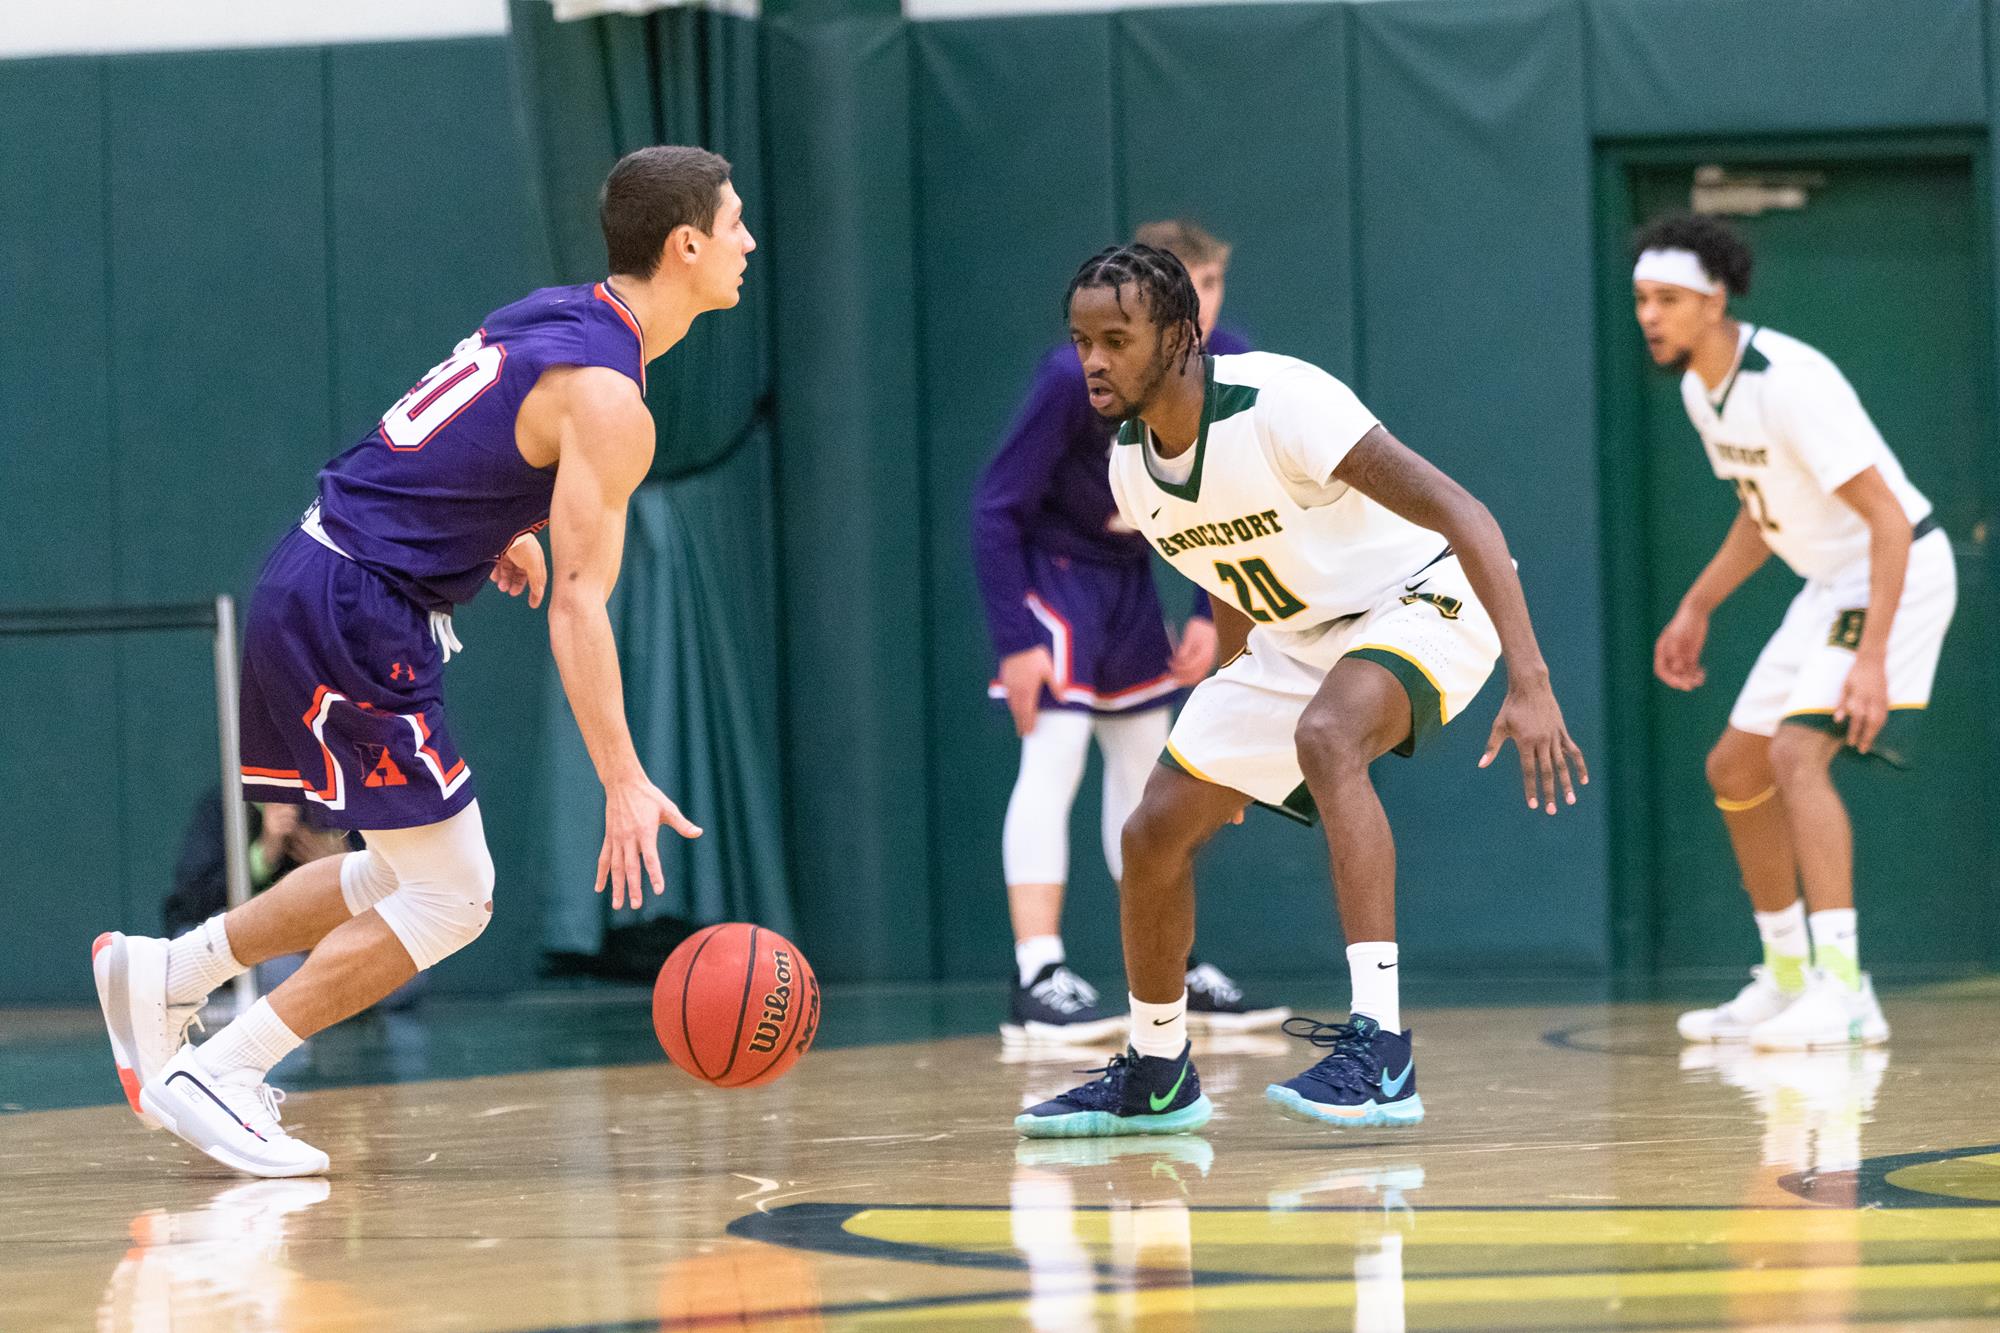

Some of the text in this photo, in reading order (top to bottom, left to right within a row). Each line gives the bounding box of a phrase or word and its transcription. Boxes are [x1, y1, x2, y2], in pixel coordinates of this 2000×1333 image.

[379, 328, 507, 452] 0
[1156, 509, 1283, 557] BROCKPORT
[1212, 556, 1310, 625] 20
[747, 949, 792, 1054] Wilson
